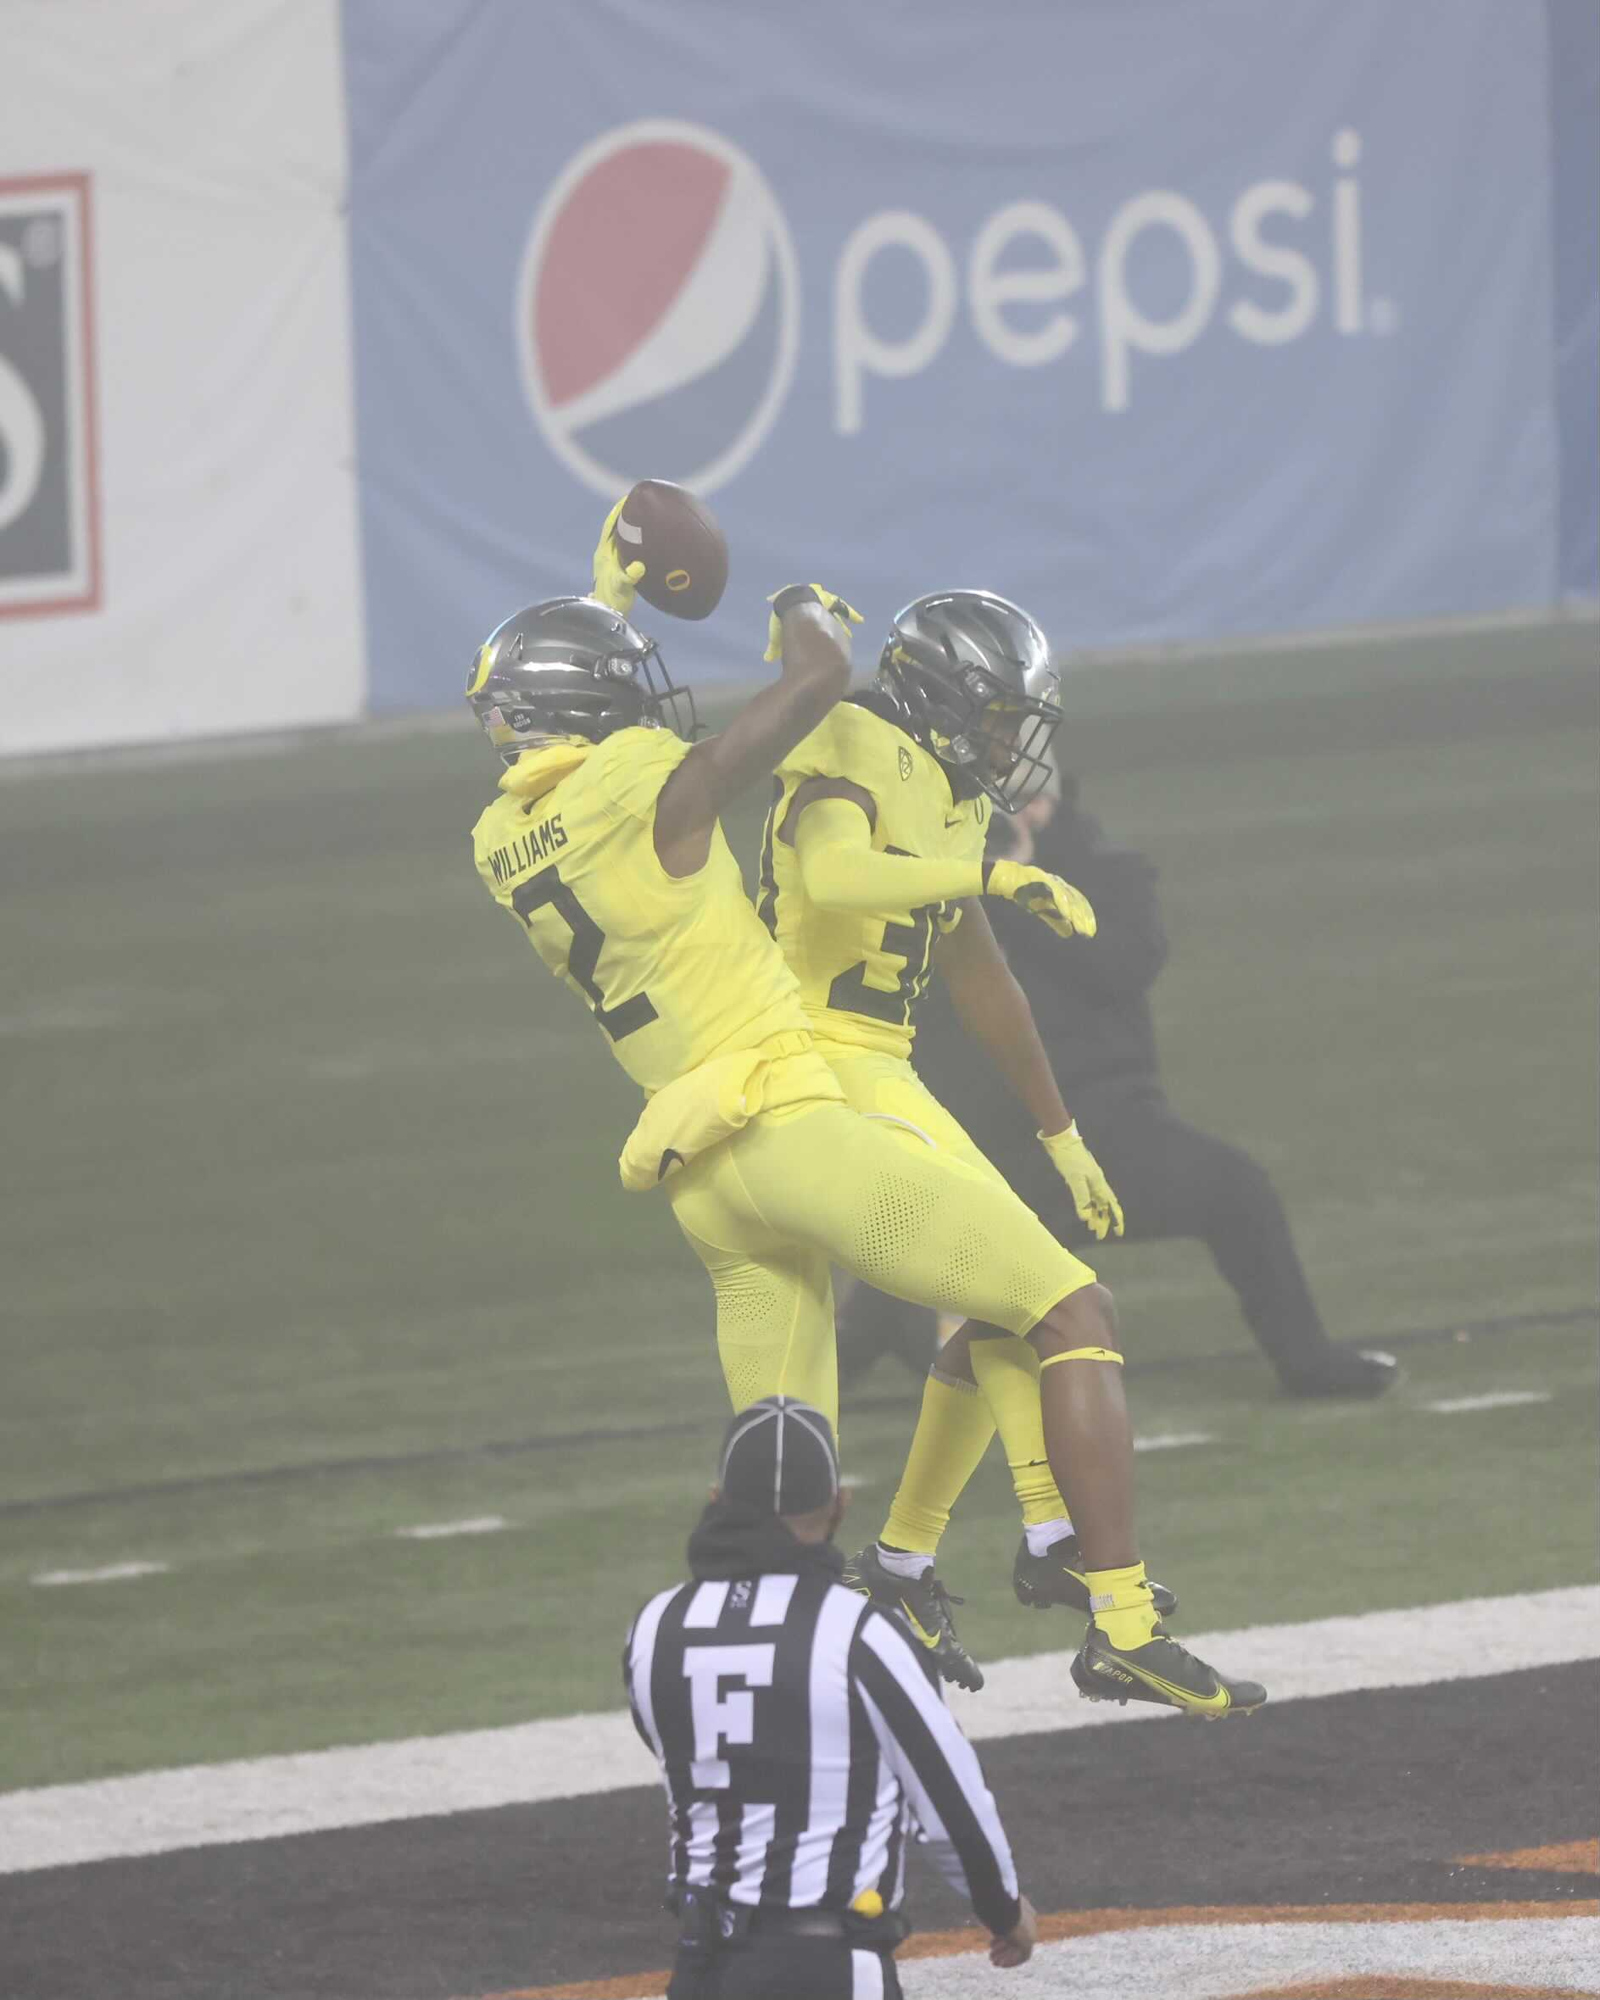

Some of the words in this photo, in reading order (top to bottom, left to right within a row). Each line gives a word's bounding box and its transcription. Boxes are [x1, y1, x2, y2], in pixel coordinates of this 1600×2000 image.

[835, 129, 1362, 434] pepsi
[487, 813, 569, 887] WILLIAMS
[511, 863, 659, 1043] 2
[682, 1644, 776, 1789] F
